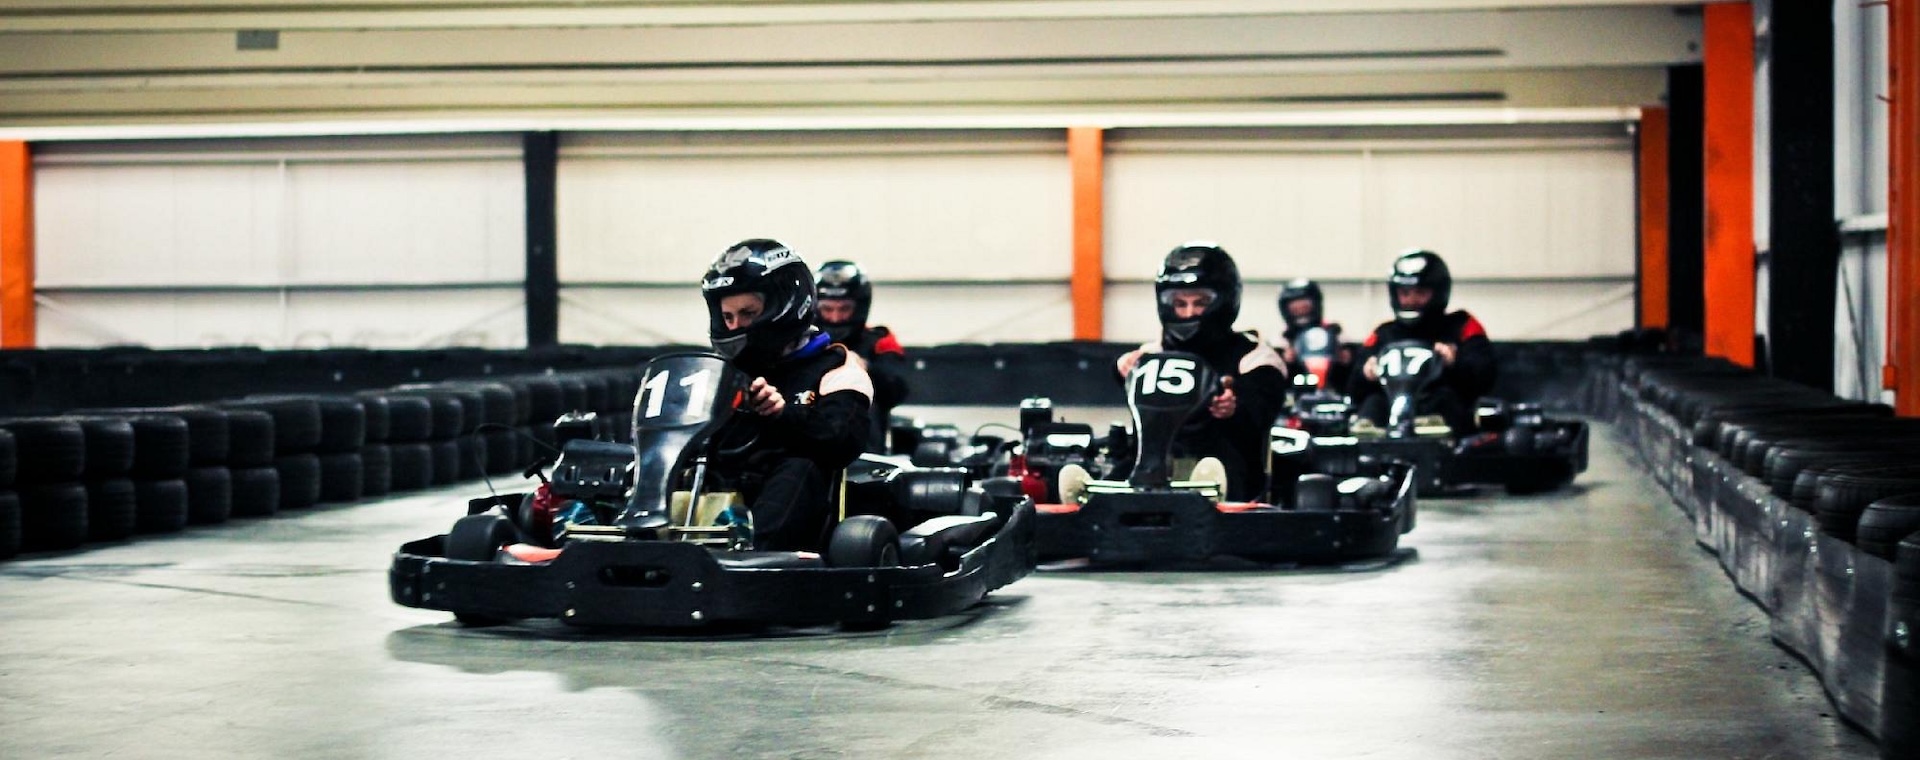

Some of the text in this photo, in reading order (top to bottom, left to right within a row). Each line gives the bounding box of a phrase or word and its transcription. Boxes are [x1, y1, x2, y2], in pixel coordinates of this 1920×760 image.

[1134, 358, 1196, 395] 15
[1379, 347, 1433, 377] 17
[644, 369, 711, 418] 11
